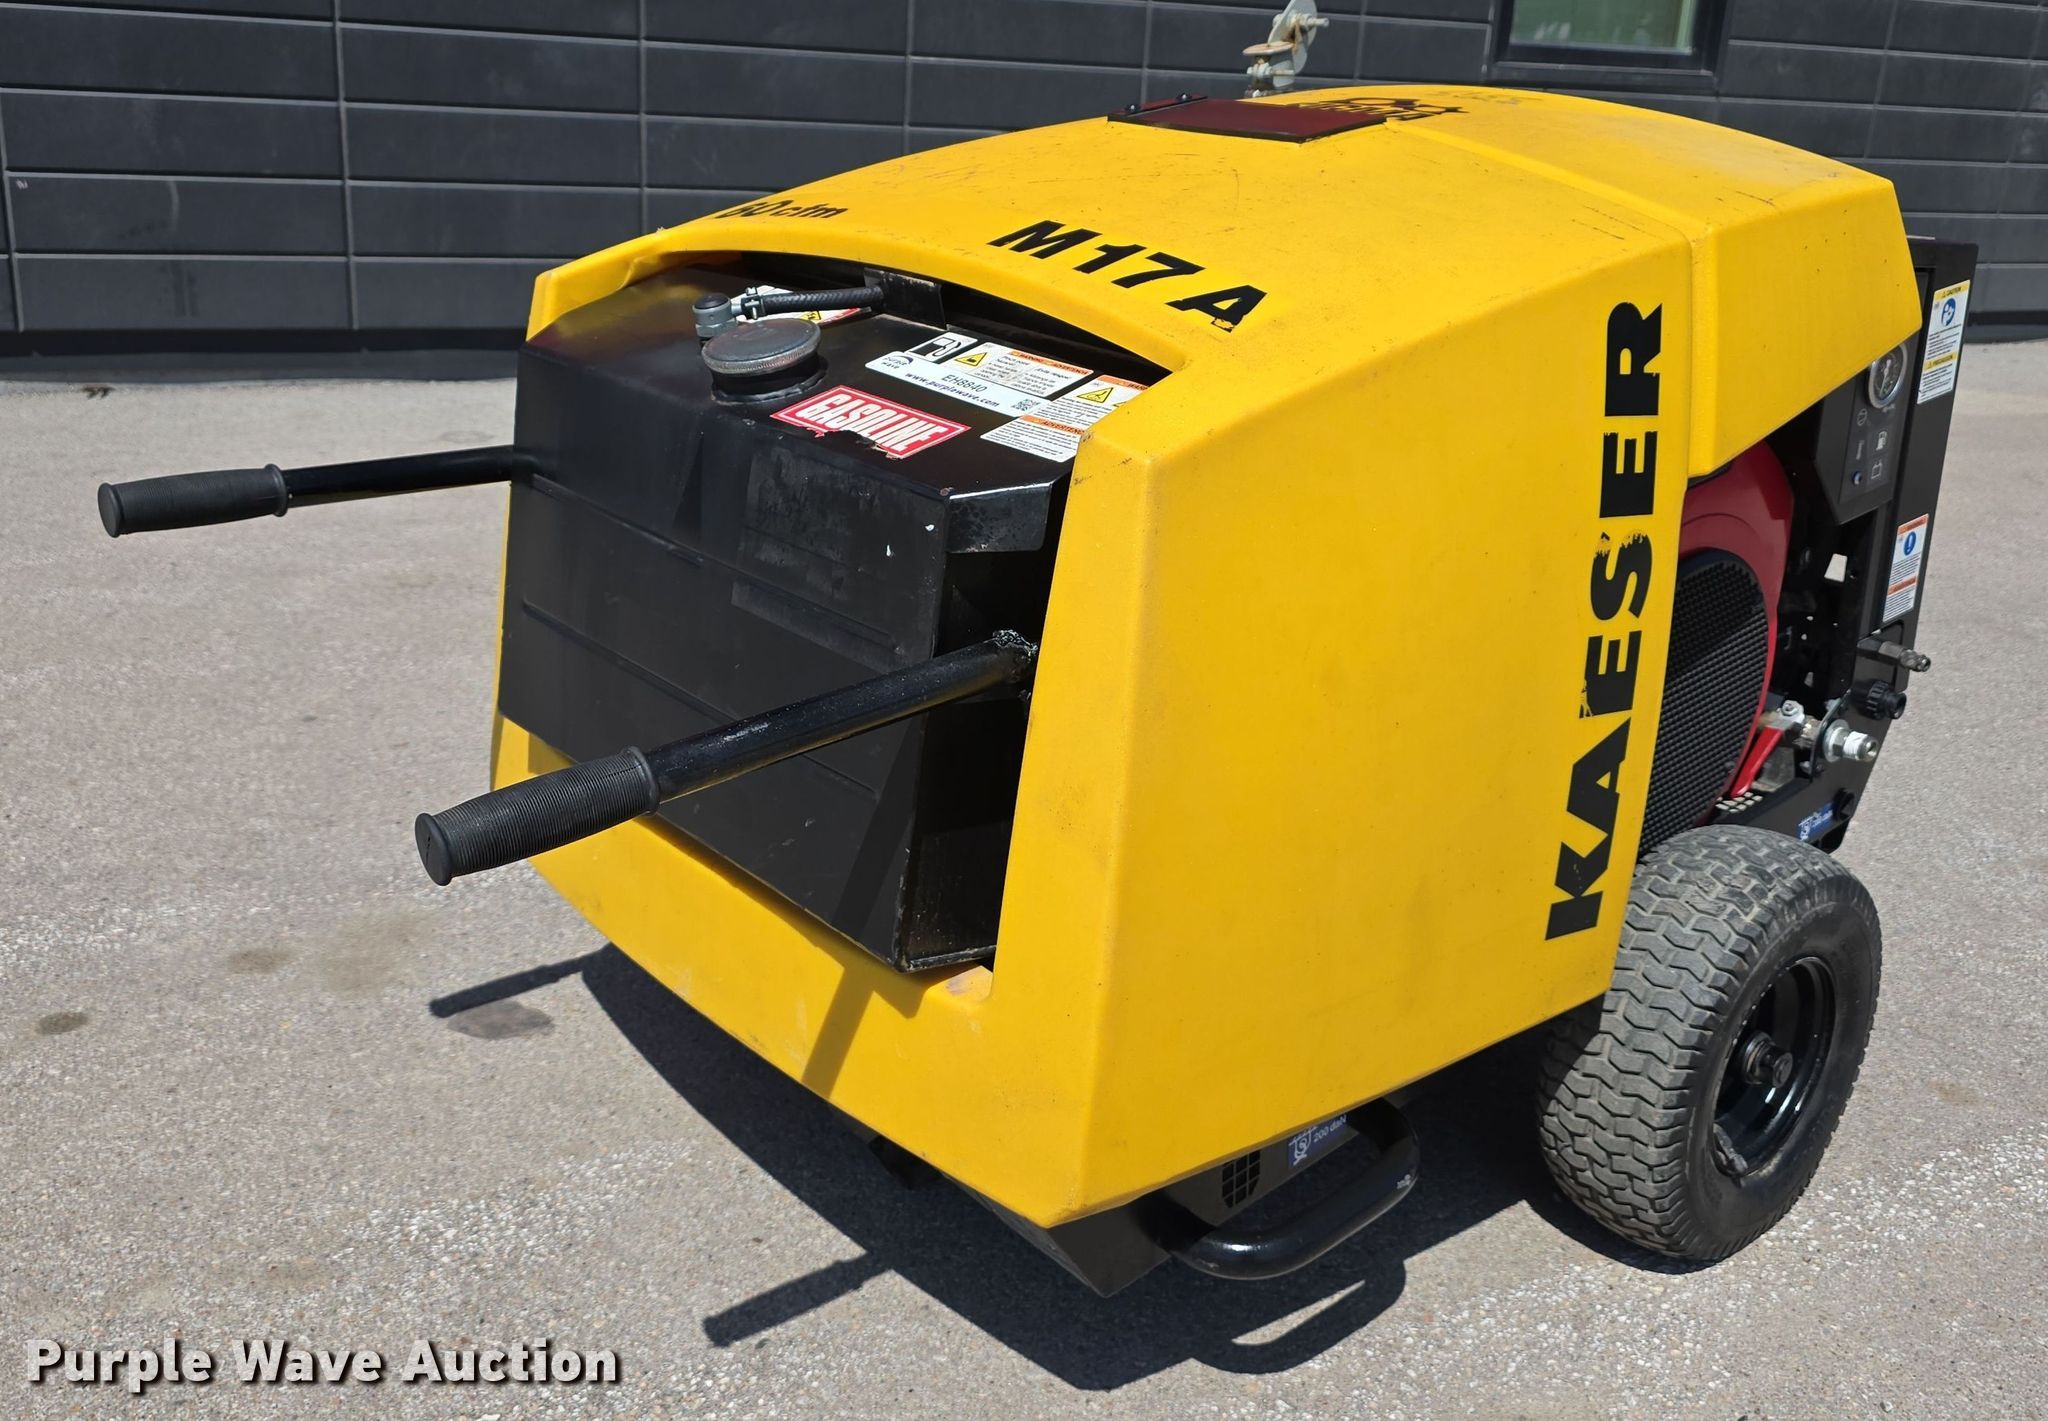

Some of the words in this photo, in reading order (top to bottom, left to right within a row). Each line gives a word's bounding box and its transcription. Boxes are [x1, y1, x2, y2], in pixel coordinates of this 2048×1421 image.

[905, 373, 1001, 408] www.purplewave.com
[941, 373, 988, 393] EH8840
[795, 393, 949, 452] GASOLINE
[1544, 301, 1663, 941] KAESER
